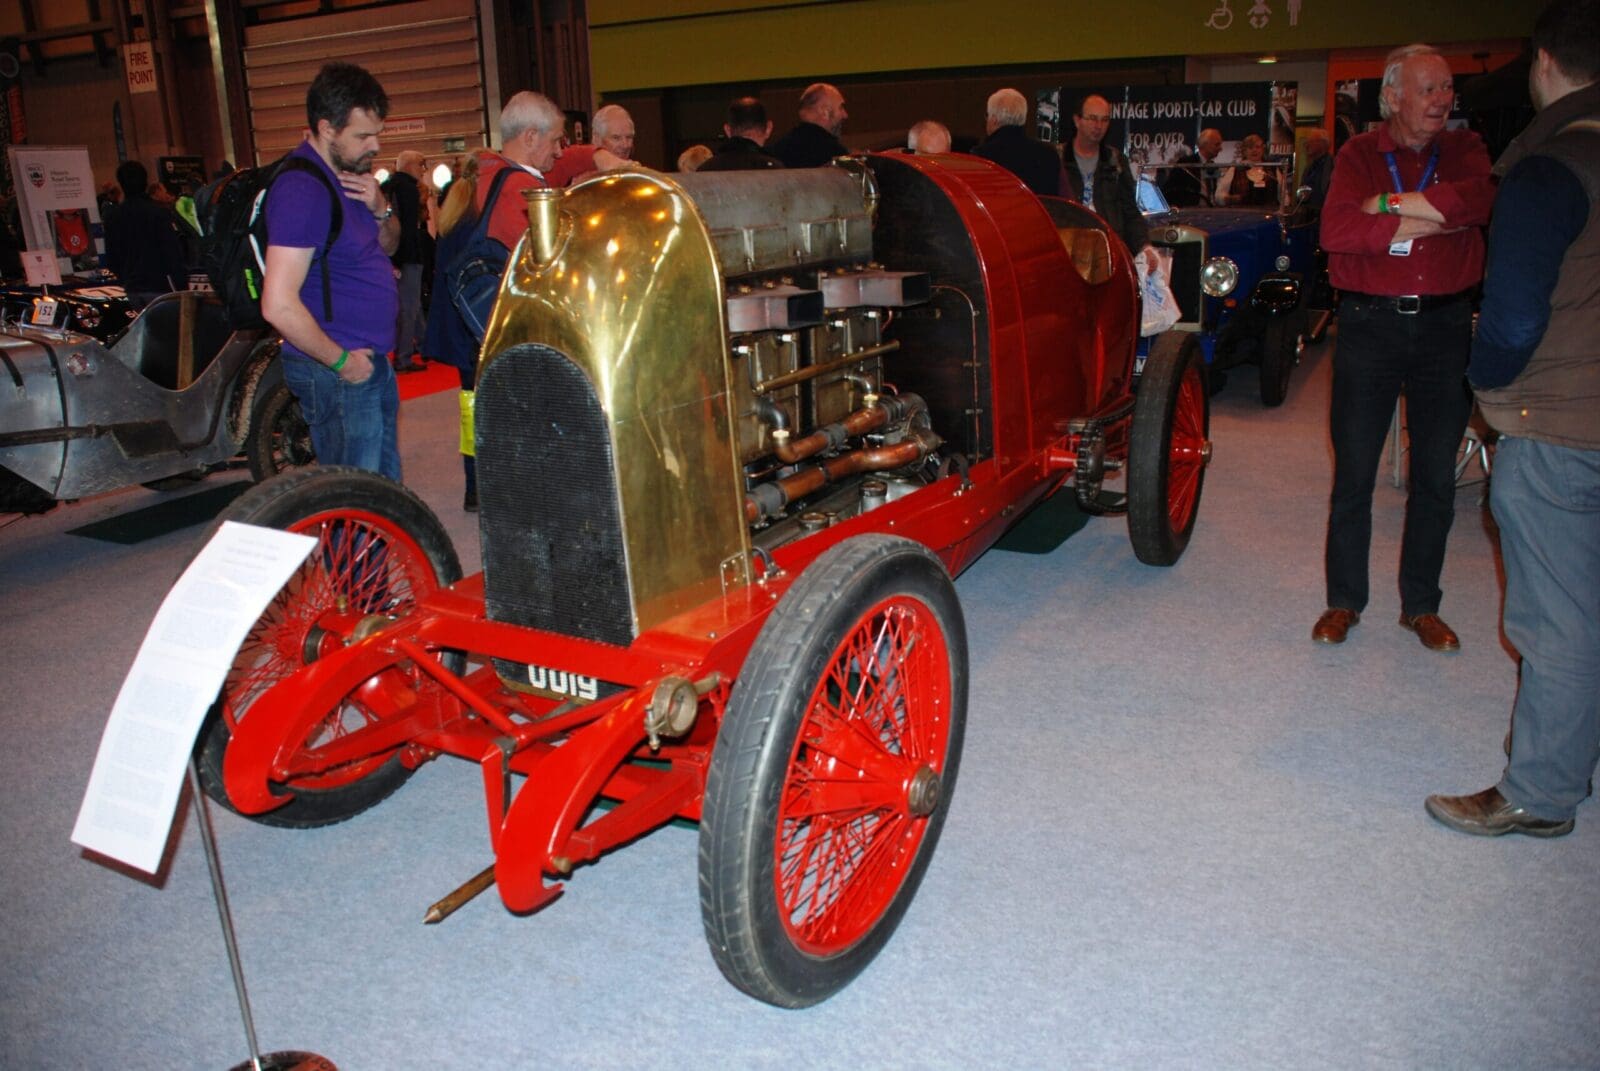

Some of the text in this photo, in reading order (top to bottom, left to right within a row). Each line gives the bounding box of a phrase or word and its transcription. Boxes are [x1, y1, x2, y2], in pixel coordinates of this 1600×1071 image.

[129, 52, 149, 66] FIRE
[129, 69, 153, 84] POINT
[1110, 98, 1256, 119] INTAGE SPORTS-CAR CLUB
[1129, 131, 1185, 149] FOR OVER
